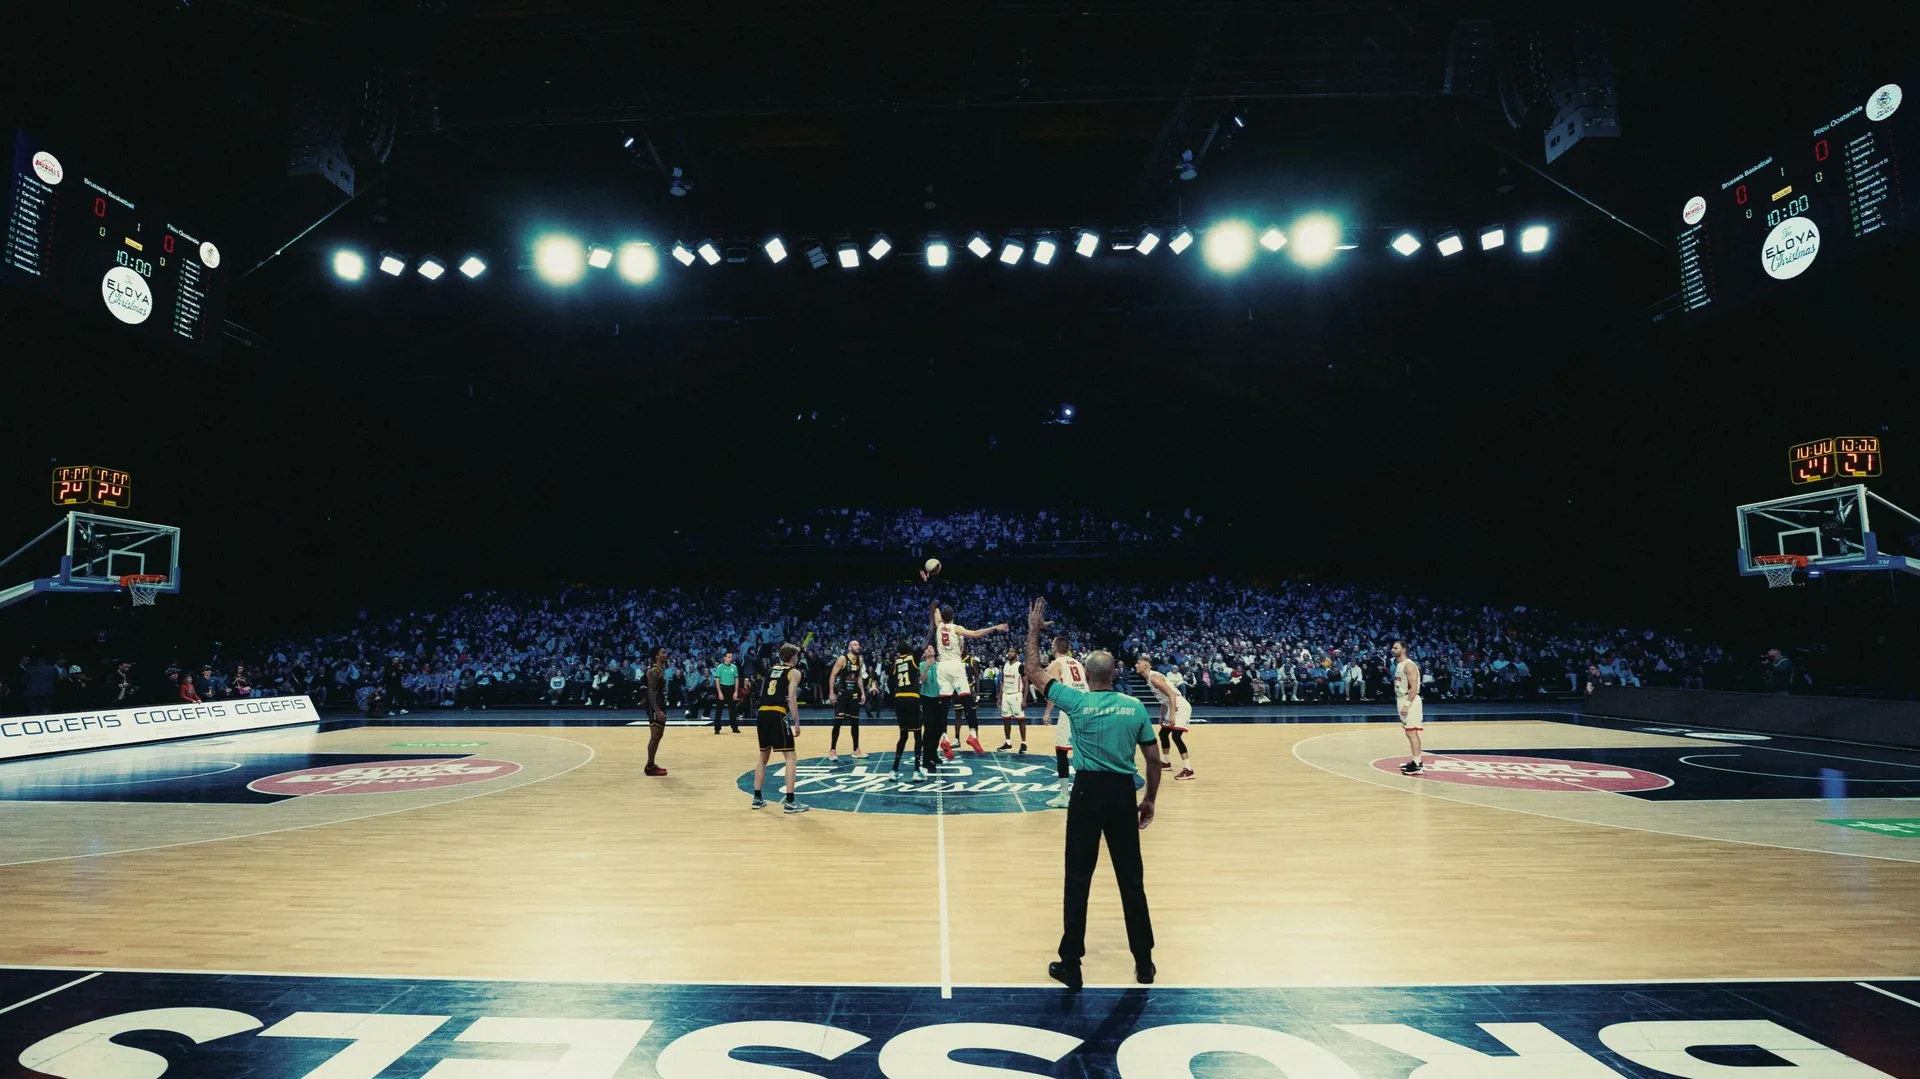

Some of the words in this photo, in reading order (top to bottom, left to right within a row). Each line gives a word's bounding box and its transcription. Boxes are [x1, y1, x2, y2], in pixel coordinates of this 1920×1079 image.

[1830, 105, 1863, 127] Oostende
[1815, 140, 1828, 161] 0
[1722, 174, 1744, 190] Brussels
[1744, 157, 1773, 176] Basketball
[1815, 172, 1823, 182] 0
[1736, 185, 1747, 205] 0
[95, 198, 106, 217] 0
[1746, 209, 1752, 219] 0
[1767, 195, 1809, 227] 10:00
[100, 226, 106, 236] 0
[164, 235, 174, 253] 0
[1766, 230, 1816, 259] ELOYA
[116, 250, 152, 277] 10:00
[159, 257, 166, 267] 0
[1770, 243, 1816, 272] Christmas
[107, 278, 150, 306] ELOYA
[107, 289, 147, 316] Christmas
[898, 672, 911, 687] 21
[1070, 666, 1081, 682] 13
[767, 679, 777, 695] 8
[1, 714, 122, 738] COGEFIS
[134, 705, 227, 726] COGEFIS
[235, 699, 307, 716] COGEFIS
